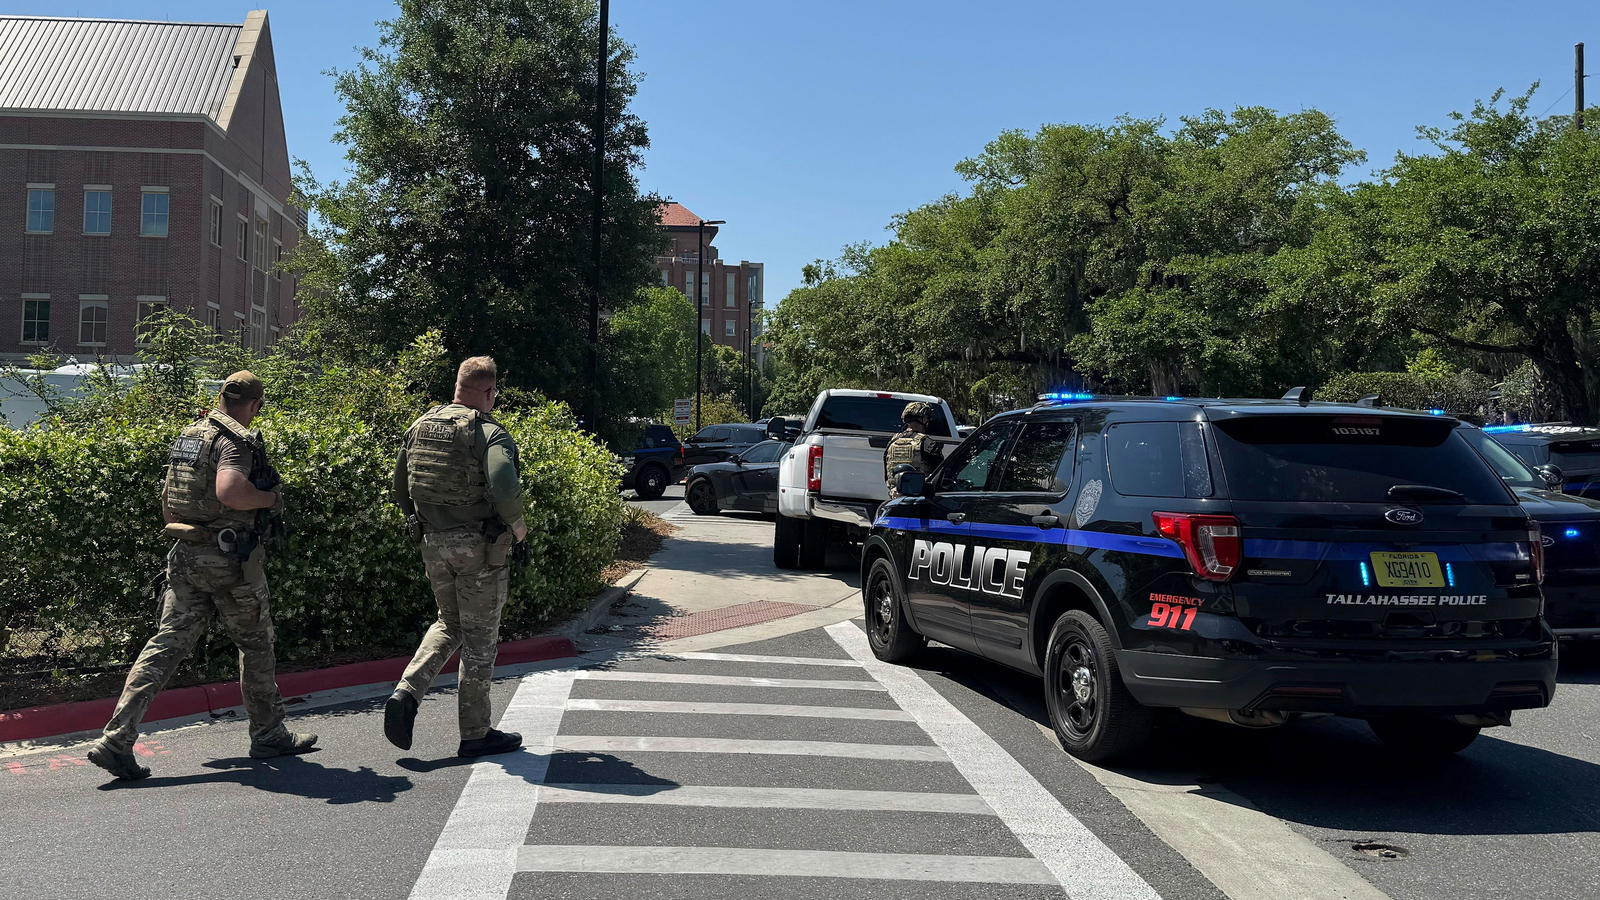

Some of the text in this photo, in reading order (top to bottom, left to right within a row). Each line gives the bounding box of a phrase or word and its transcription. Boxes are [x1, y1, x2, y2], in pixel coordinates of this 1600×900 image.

[1332, 427, 1380, 435] 103187
[908, 539, 1031, 599] POLICE
[1384, 561, 1432, 578] XG9410
[1149, 592, 1206, 607] EMERGENCY
[1325, 594, 1487, 605] TALLAHASSEE POLICE
[1147, 602, 1198, 630] 911
